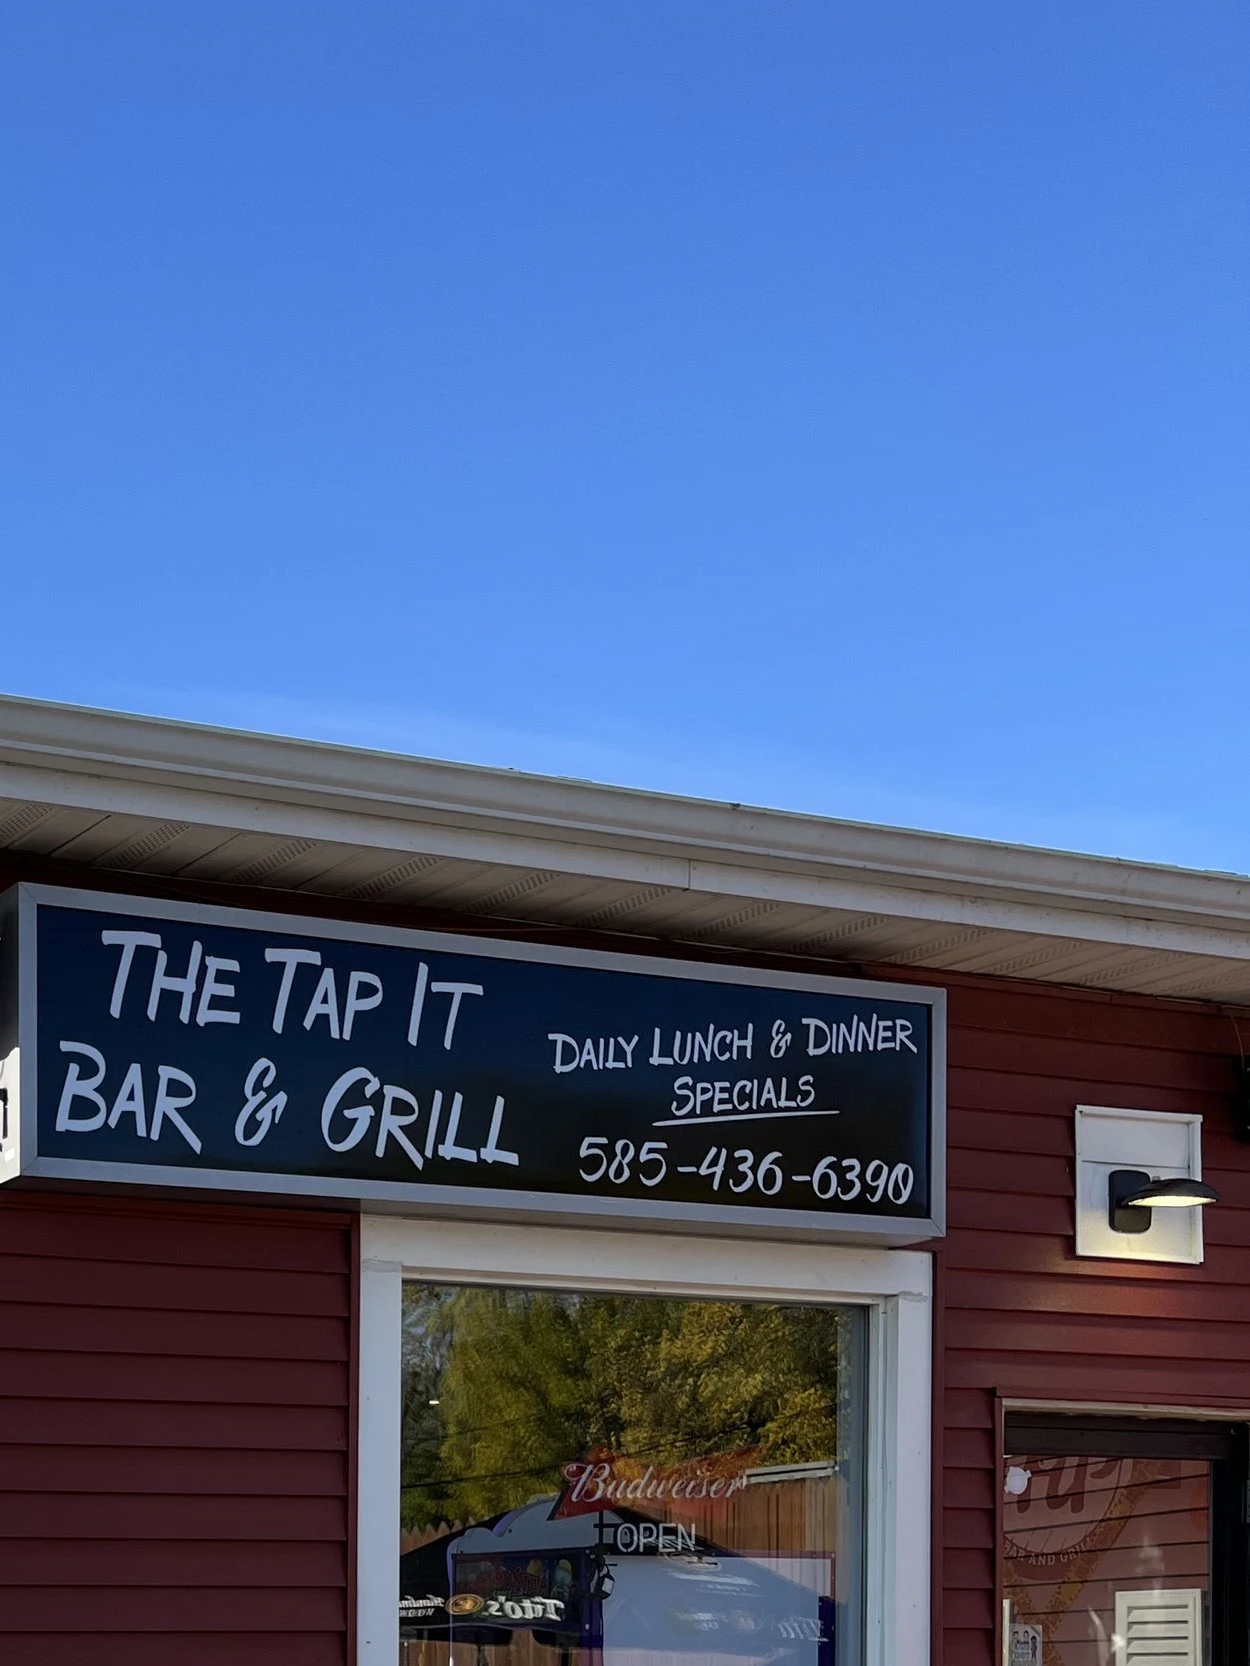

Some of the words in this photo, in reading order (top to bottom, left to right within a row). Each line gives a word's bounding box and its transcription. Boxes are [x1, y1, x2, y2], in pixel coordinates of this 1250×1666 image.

[101, 930, 241, 1027] THE
[264, 947, 383, 1041] TAP
[407, 961, 484, 1051] IT
[547, 1033, 639, 1074] DAILY
[648, 1022, 754, 1066] LUNCH
[770, 1019, 792, 1058] &
[801, 1013, 918, 1057] DINNER
[55, 1040, 202, 1155] BAR
[234, 1057, 288, 1146] &
[321, 1066, 519, 1171] GRILL
[671, 1074, 815, 1116] SPECIALS
[579, 1136, 914, 1205] 585-436-6390
[564, 1462, 742, 1502] Budweiser
[616, 1522, 696, 1552] OPEN
[1028, 1553, 1056, 1566] AND
